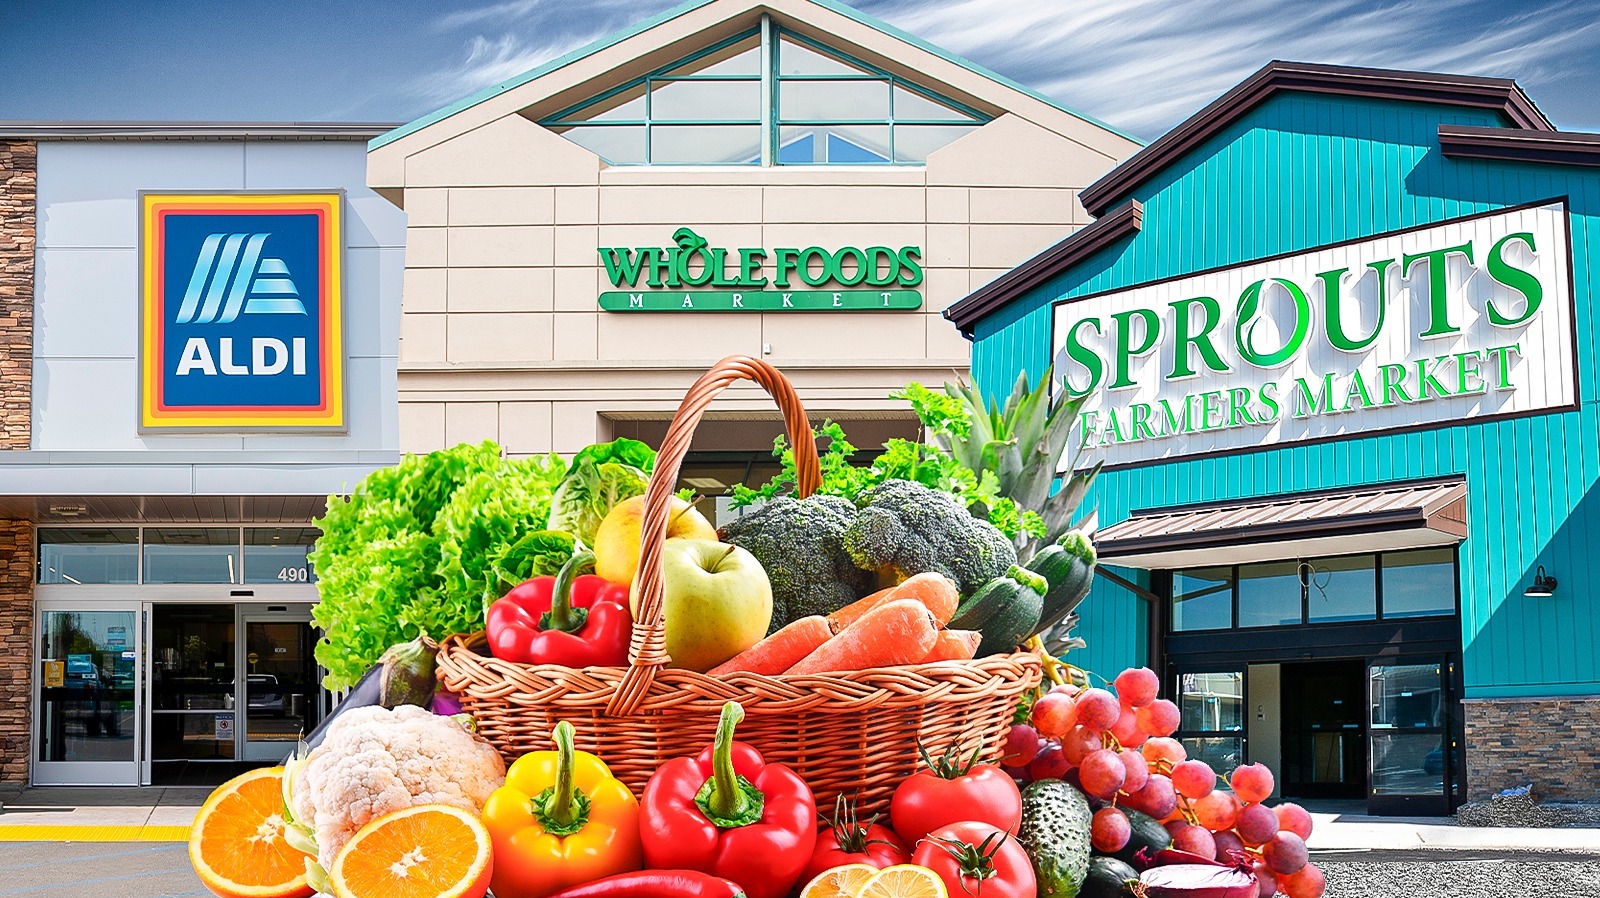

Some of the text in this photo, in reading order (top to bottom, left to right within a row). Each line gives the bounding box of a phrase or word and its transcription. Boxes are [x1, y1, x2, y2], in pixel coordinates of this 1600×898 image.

[597, 228, 923, 287] WHOLE FOODS
[629, 293, 892, 309] MARKET
[1063, 231, 1543, 397] SPROUTS
[175, 337, 306, 376] ALDI
[1078, 342, 1521, 449] FARMERS MARKET
[277, 567, 308, 582] 490
